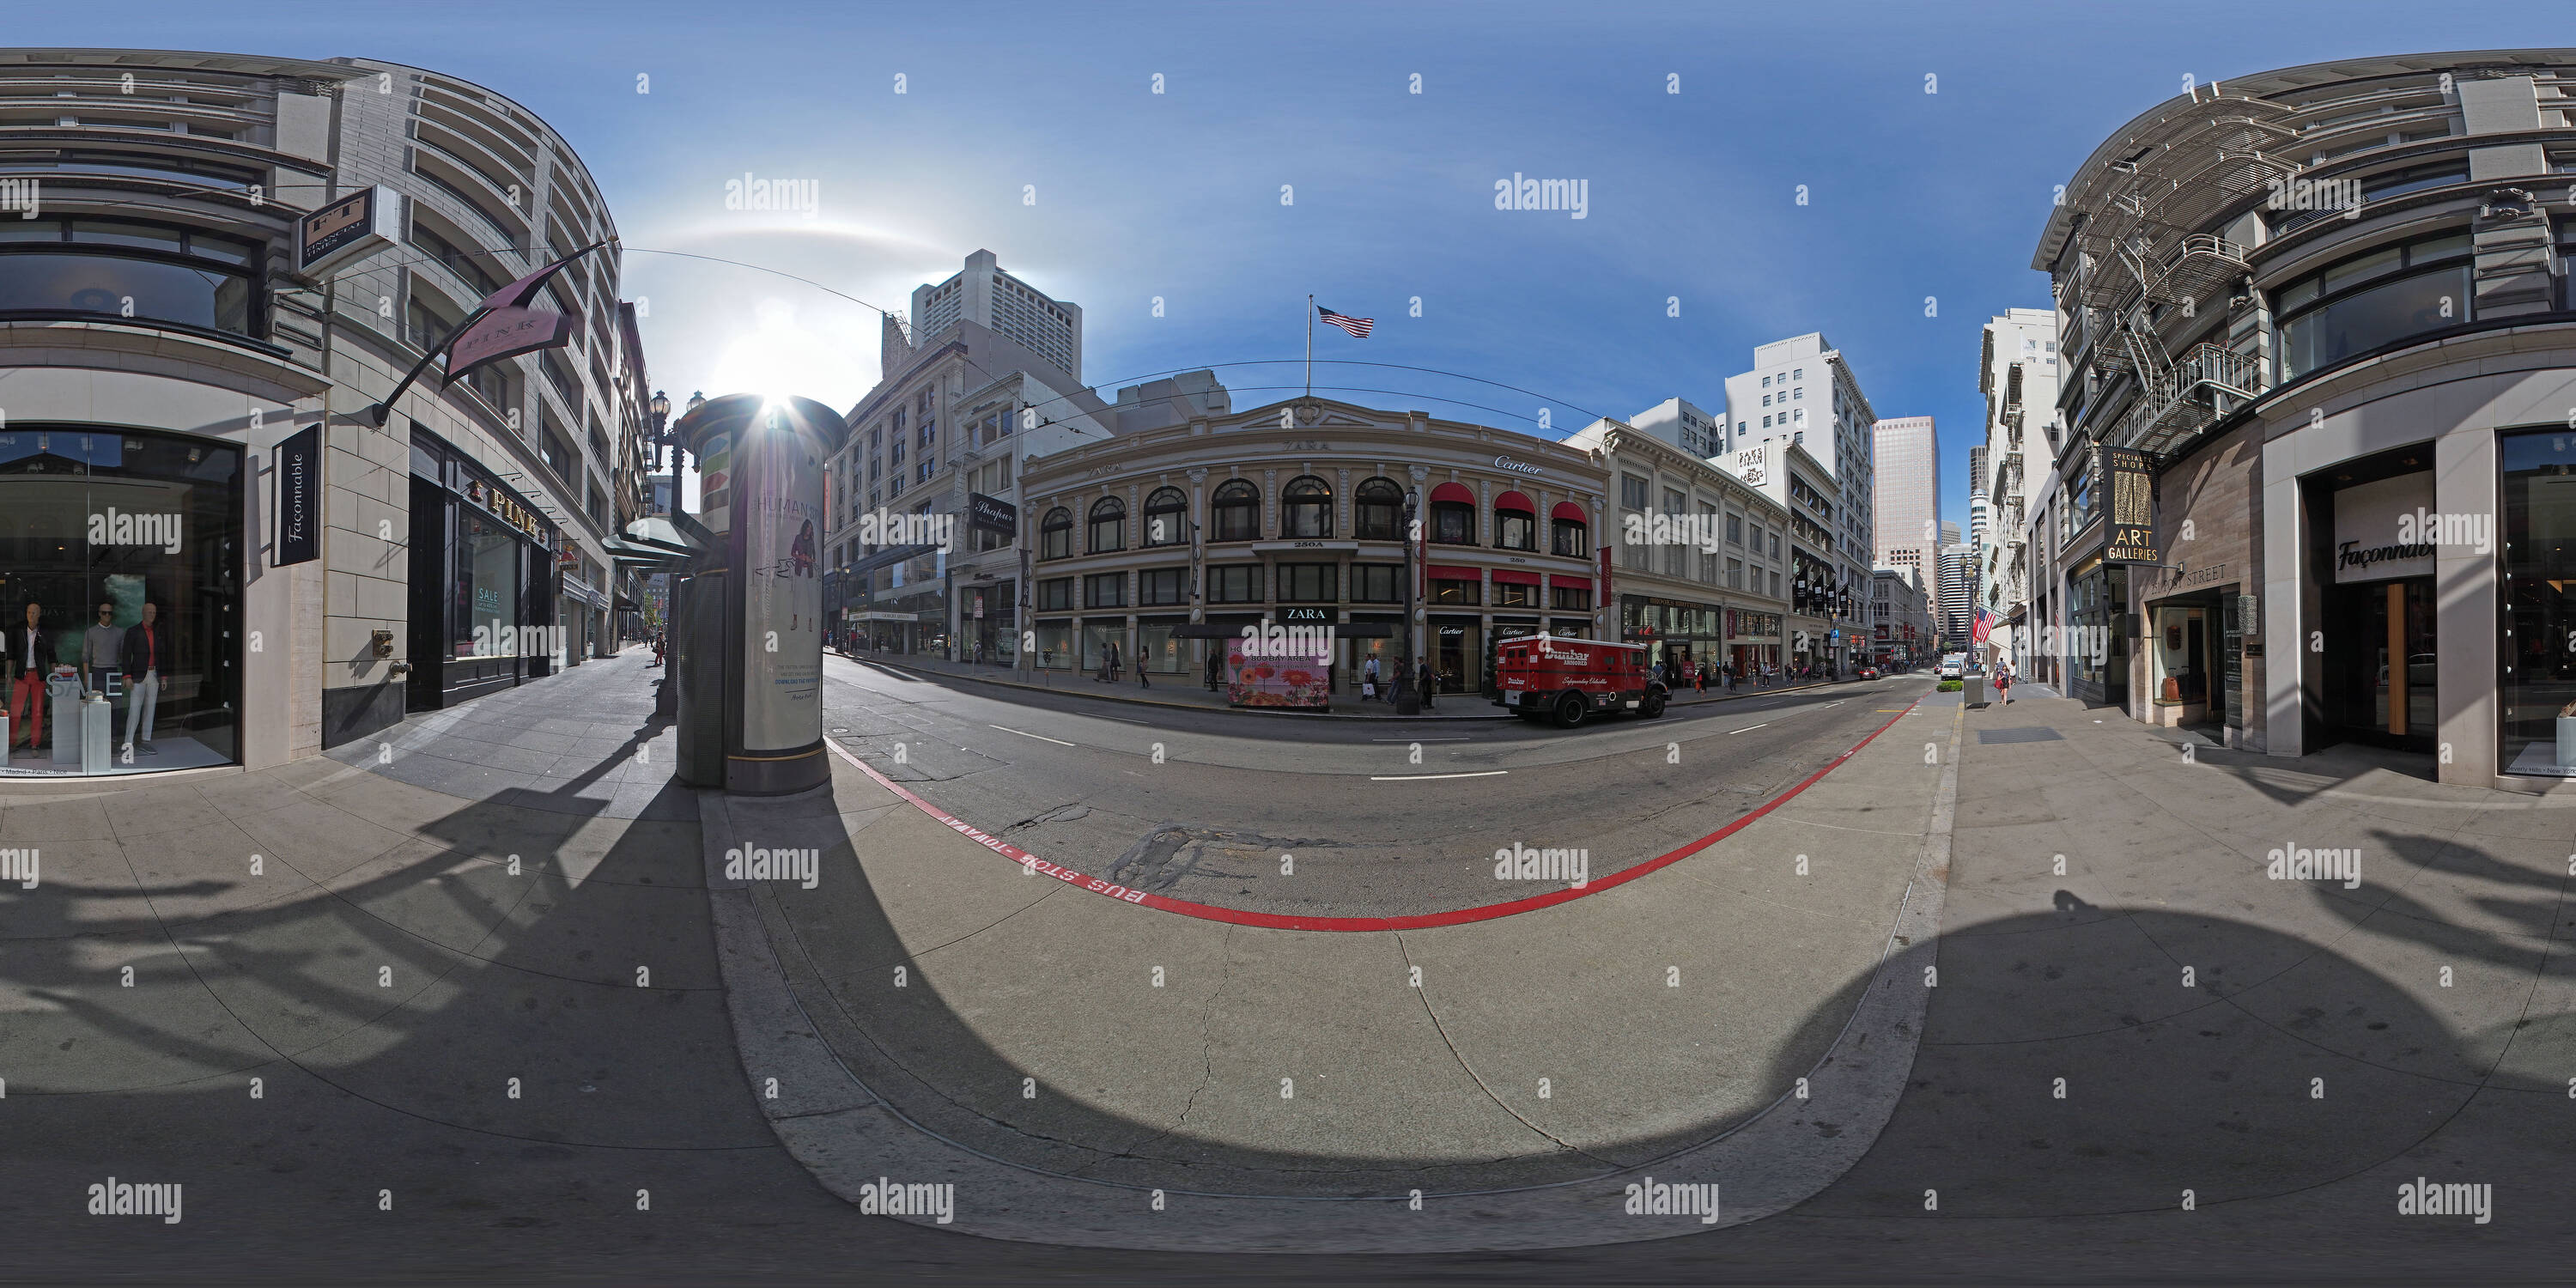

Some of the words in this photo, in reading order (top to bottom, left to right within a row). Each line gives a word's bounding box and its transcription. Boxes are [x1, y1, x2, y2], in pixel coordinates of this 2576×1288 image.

[313, 201, 360, 232] FT
[307, 222, 364, 252] FINANCIAL
[307, 238, 337, 258] TIMES
[466, 320, 537, 349] PINK
[1284, 440, 1330, 451] ZARA
[1739, 447, 1763, 459] SAKS
[1088, 461, 1121, 476] ZARA
[1494, 455, 1543, 475] Cartier
[2113, 459, 2153, 471] SHOPS
[289, 453, 303, 544] Façonnable
[489, 488, 538, 538] PINK
[975, 501, 1015, 522] Shapur
[2115, 528, 2153, 546] ART
[2108, 547, 2158, 562] GALLERIES
[2339, 540, 2437, 571] Façonnab
[2186, 563, 2226, 586] STREET
[479, 587, 498, 601] SALE
[1287, 609, 1326, 619] ZARA
[1439, 626, 1464, 635] Cartier
[1558, 629, 1577, 637] Cartier
[1544, 647, 1589, 661] Dunbar
[46, 672, 123, 697] SALE
[1508, 677, 1525, 685] Dunbar
[1087, 879, 1147, 903] BUS
